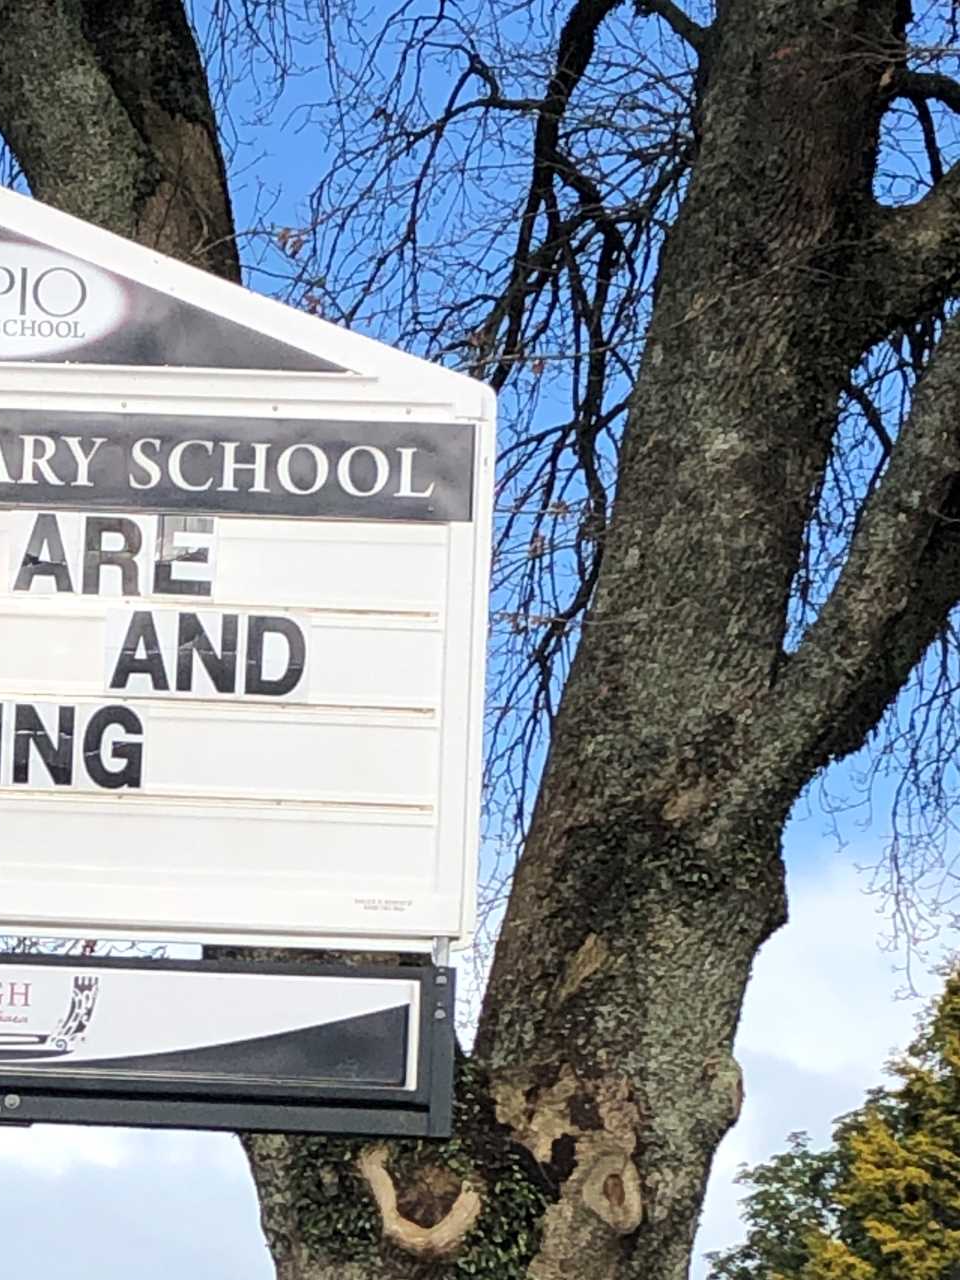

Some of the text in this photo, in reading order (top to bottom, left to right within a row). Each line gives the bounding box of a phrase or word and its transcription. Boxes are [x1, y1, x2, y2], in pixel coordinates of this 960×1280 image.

[128, 437, 436, 499] SCHOOL
[12, 512, 214, 597] ARE
[109, 610, 306, 696] AND
